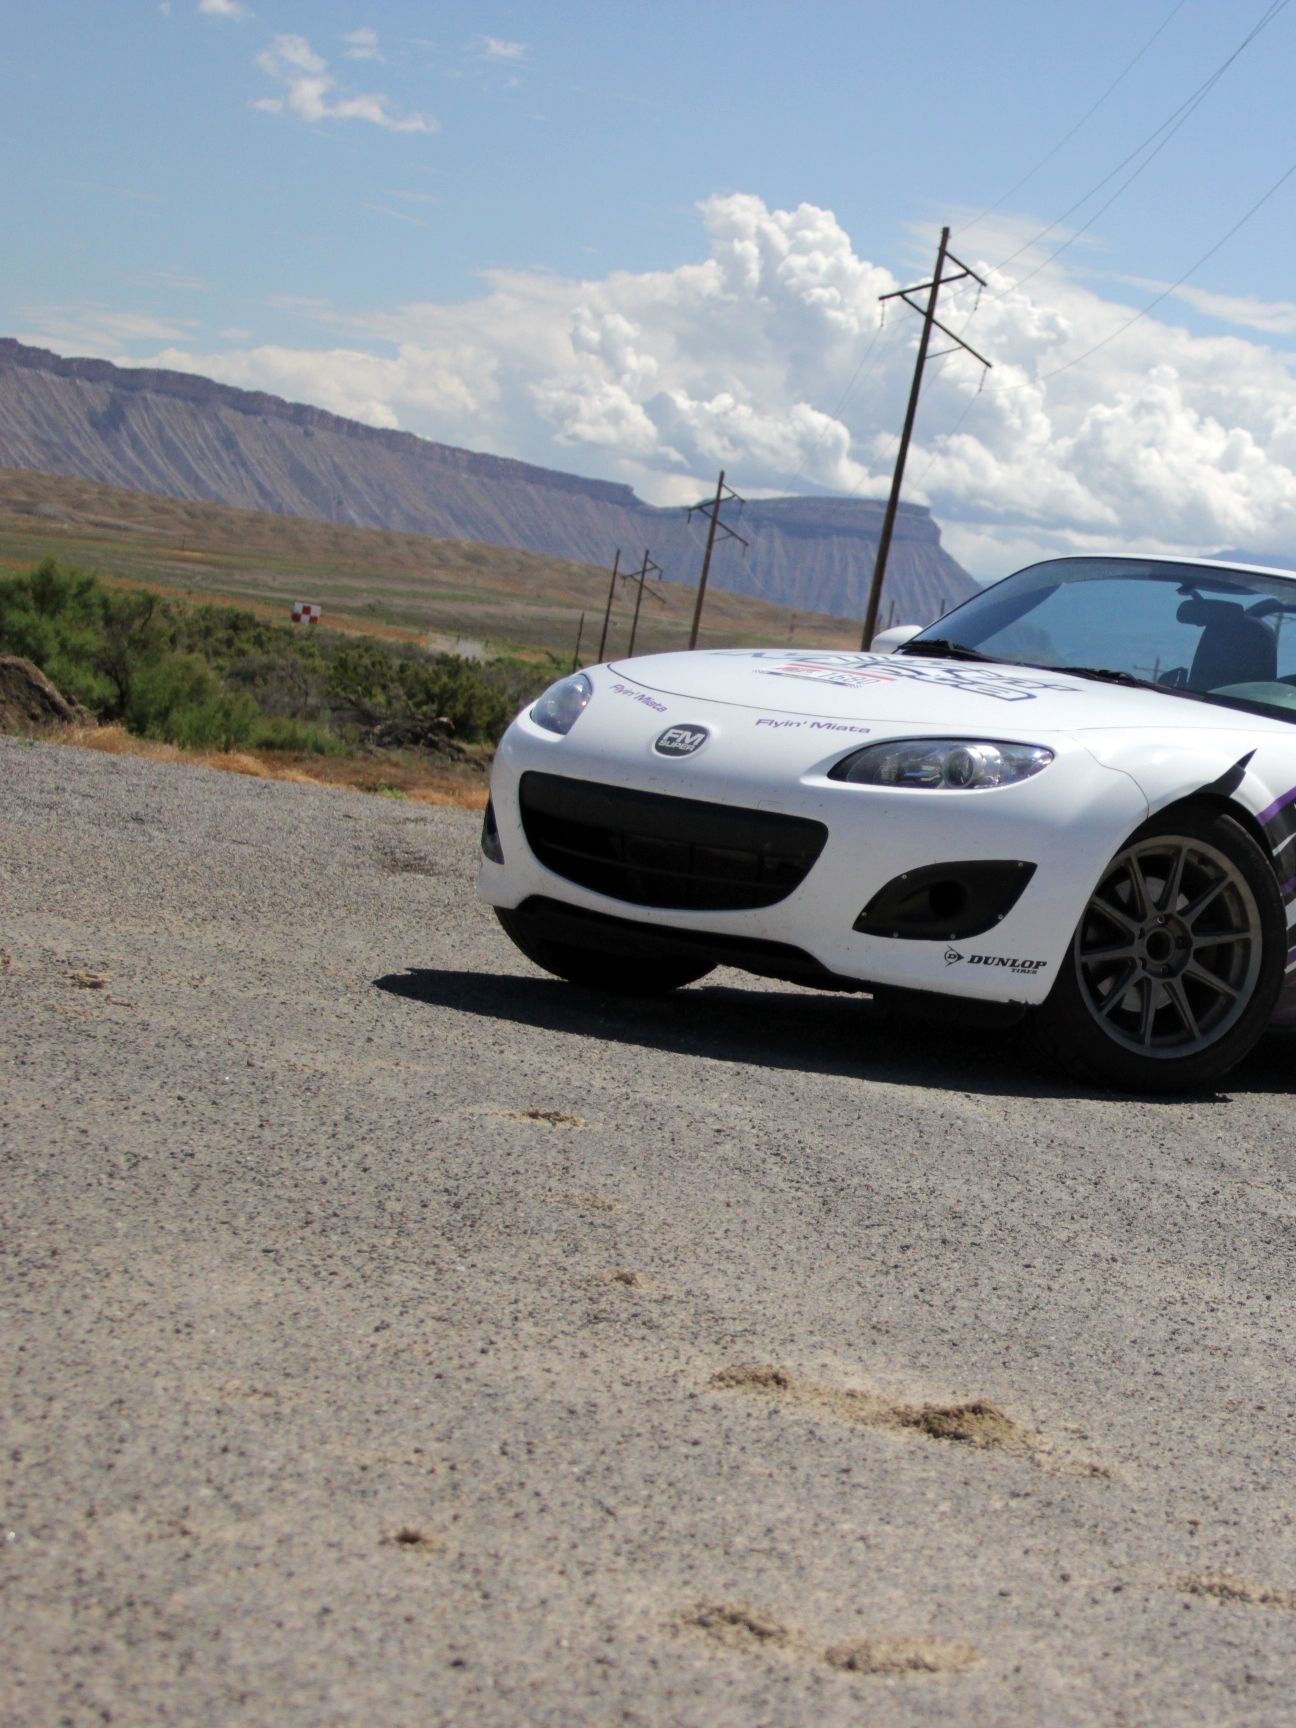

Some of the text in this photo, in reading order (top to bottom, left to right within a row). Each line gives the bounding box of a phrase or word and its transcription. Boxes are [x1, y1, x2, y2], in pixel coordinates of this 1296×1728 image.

[755, 718, 871, 734] Flyin' Miata
[662, 728, 705, 746] FM
[658, 740, 695, 752] SUPER
[967, 954, 1047, 970] DUNLOP
